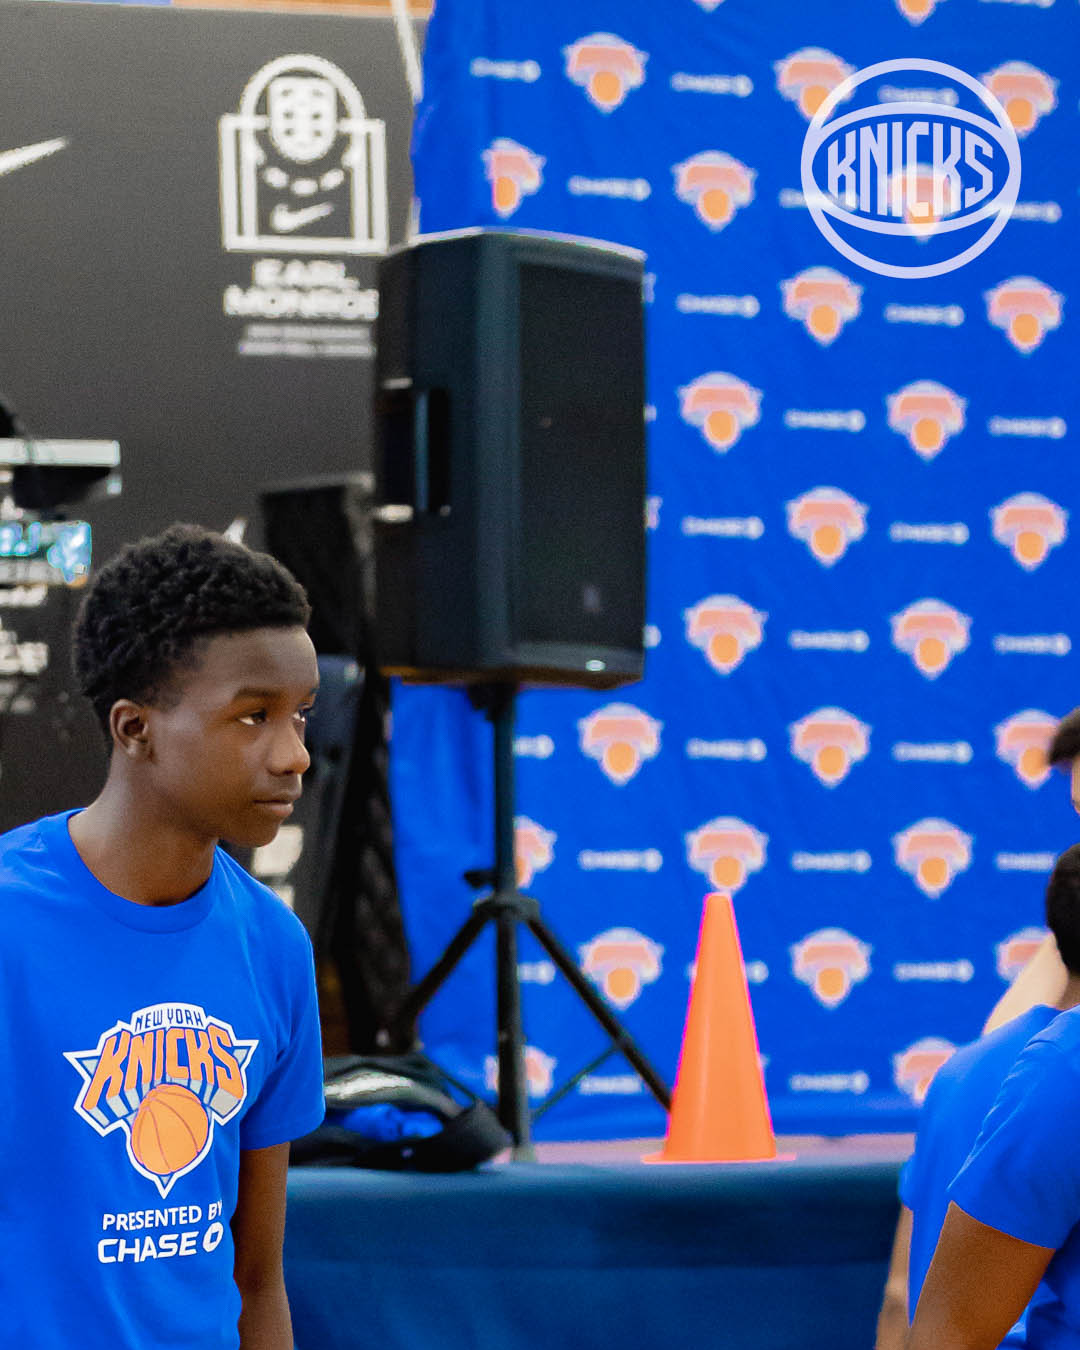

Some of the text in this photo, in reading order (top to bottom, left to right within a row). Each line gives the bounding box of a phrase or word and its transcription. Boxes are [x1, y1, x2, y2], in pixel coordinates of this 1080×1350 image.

[135, 1008, 204, 1032] NEW YORK
[82, 1025, 244, 1111] KNICKS
[102, 1198, 223, 1231] PRESENTED BY
[97, 1231, 200, 1264] CHASE
